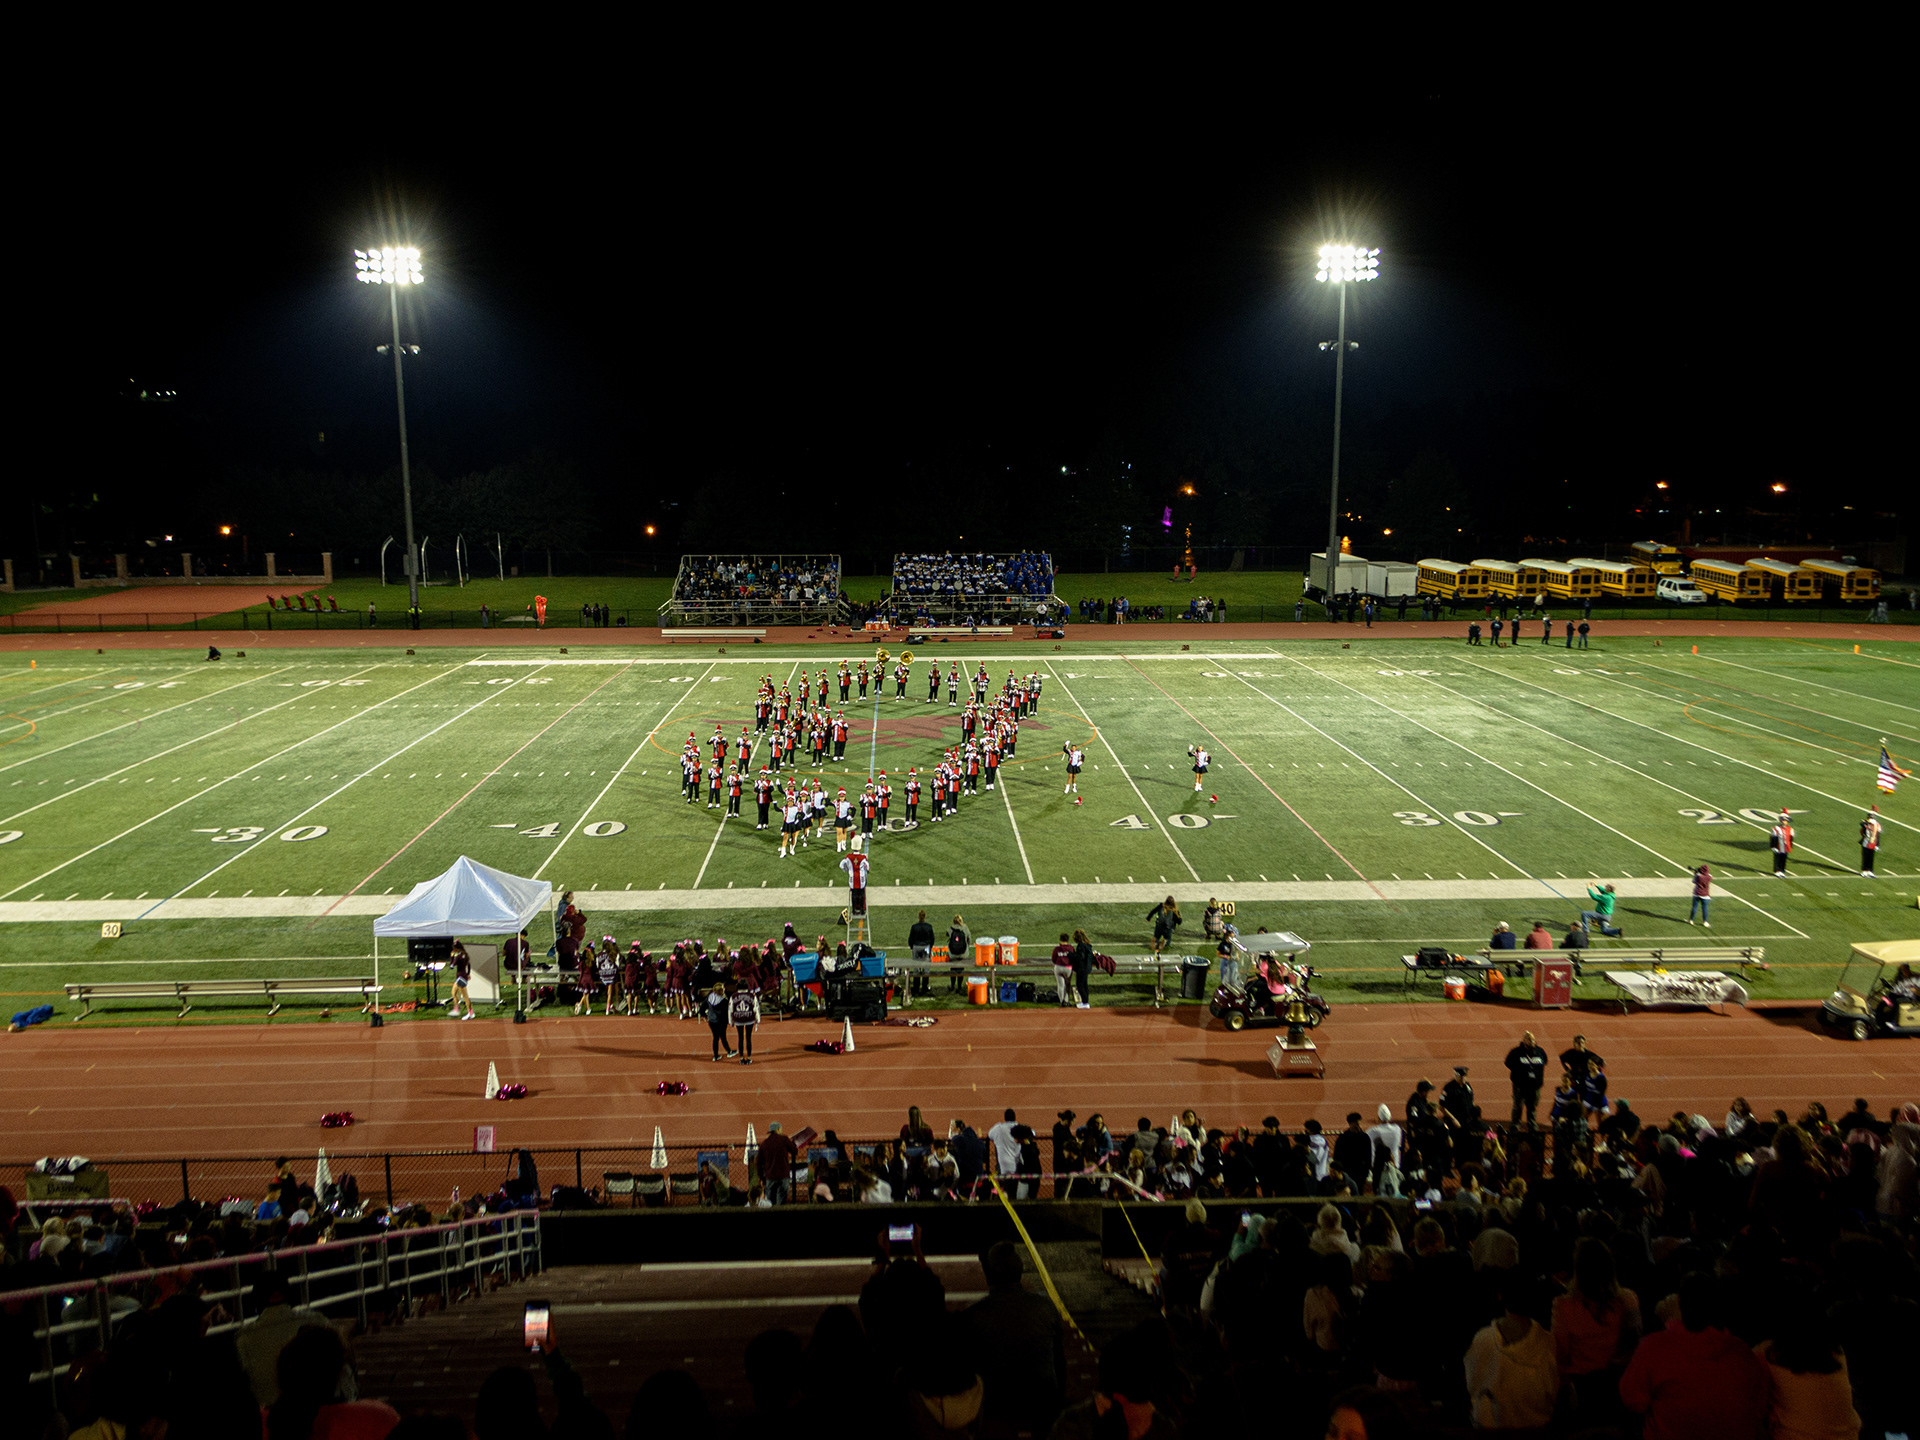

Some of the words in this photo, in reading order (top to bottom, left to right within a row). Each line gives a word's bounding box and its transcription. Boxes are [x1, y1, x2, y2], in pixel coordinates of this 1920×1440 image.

[1109, 813, 1211, 831] 40
[1391, 810, 1502, 826] 30
[1677, 808, 1781, 824] 20
[211, 825, 330, 844] 30
[518, 820, 627, 839] 40
[1219, 903, 1233, 915] 40
[103, 924, 119, 937] 30
